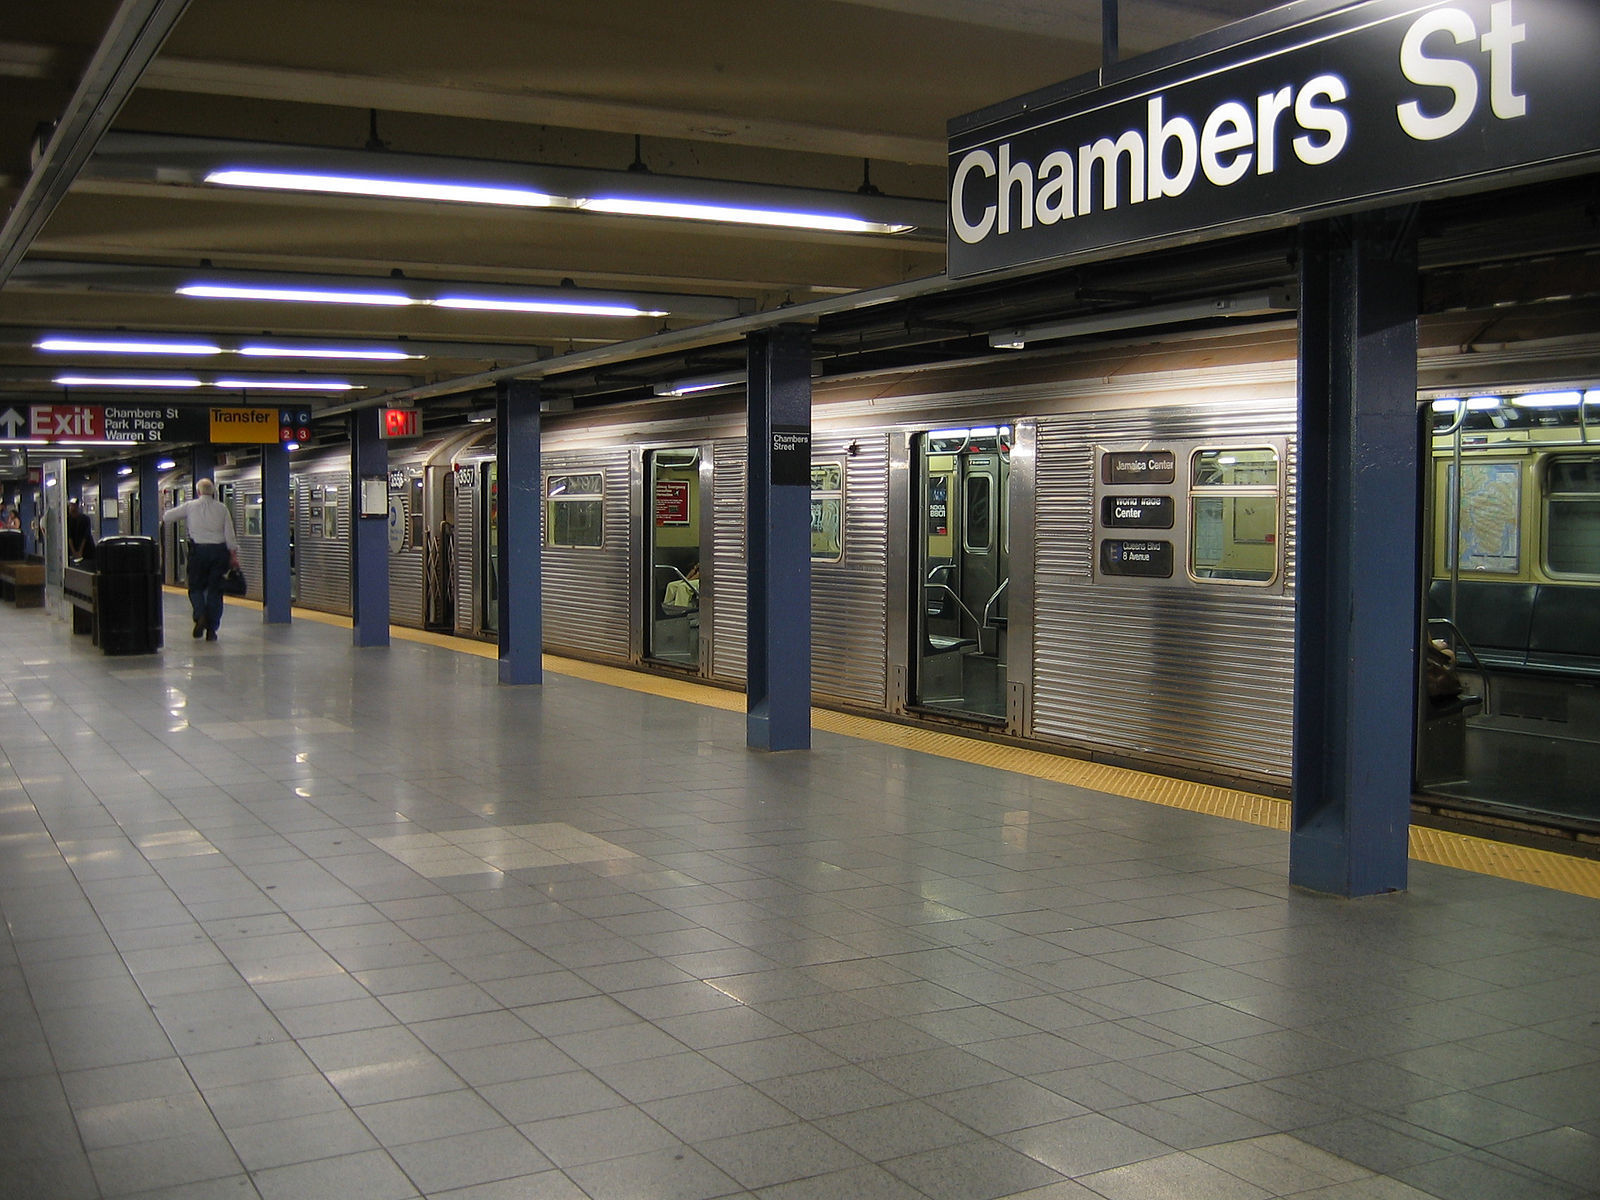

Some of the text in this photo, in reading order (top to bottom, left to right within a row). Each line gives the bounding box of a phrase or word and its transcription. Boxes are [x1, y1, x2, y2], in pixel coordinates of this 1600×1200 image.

[951, 2, 1527, 244] Chambers St
[105, 407, 179, 418] Chambers St
[211, 409, 270, 423] Transfer
[283, 413, 307, 422] A C
[31, 406, 95, 435] Exit
[105, 419, 165, 429] Park Place
[385, 410, 417, 435] EXIT
[106, 430, 161, 440] Warren St
[283, 430, 306, 438] 2 3
[773, 434, 808, 443] Chambers
[773, 442, 795, 451] Street
[1116, 460, 1173, 471] Jamaica Center
[1115, 507, 1141, 518] Center
[1122, 541, 1146, 551] Queens
[1122, 552, 1150, 561] 8 Avenue
